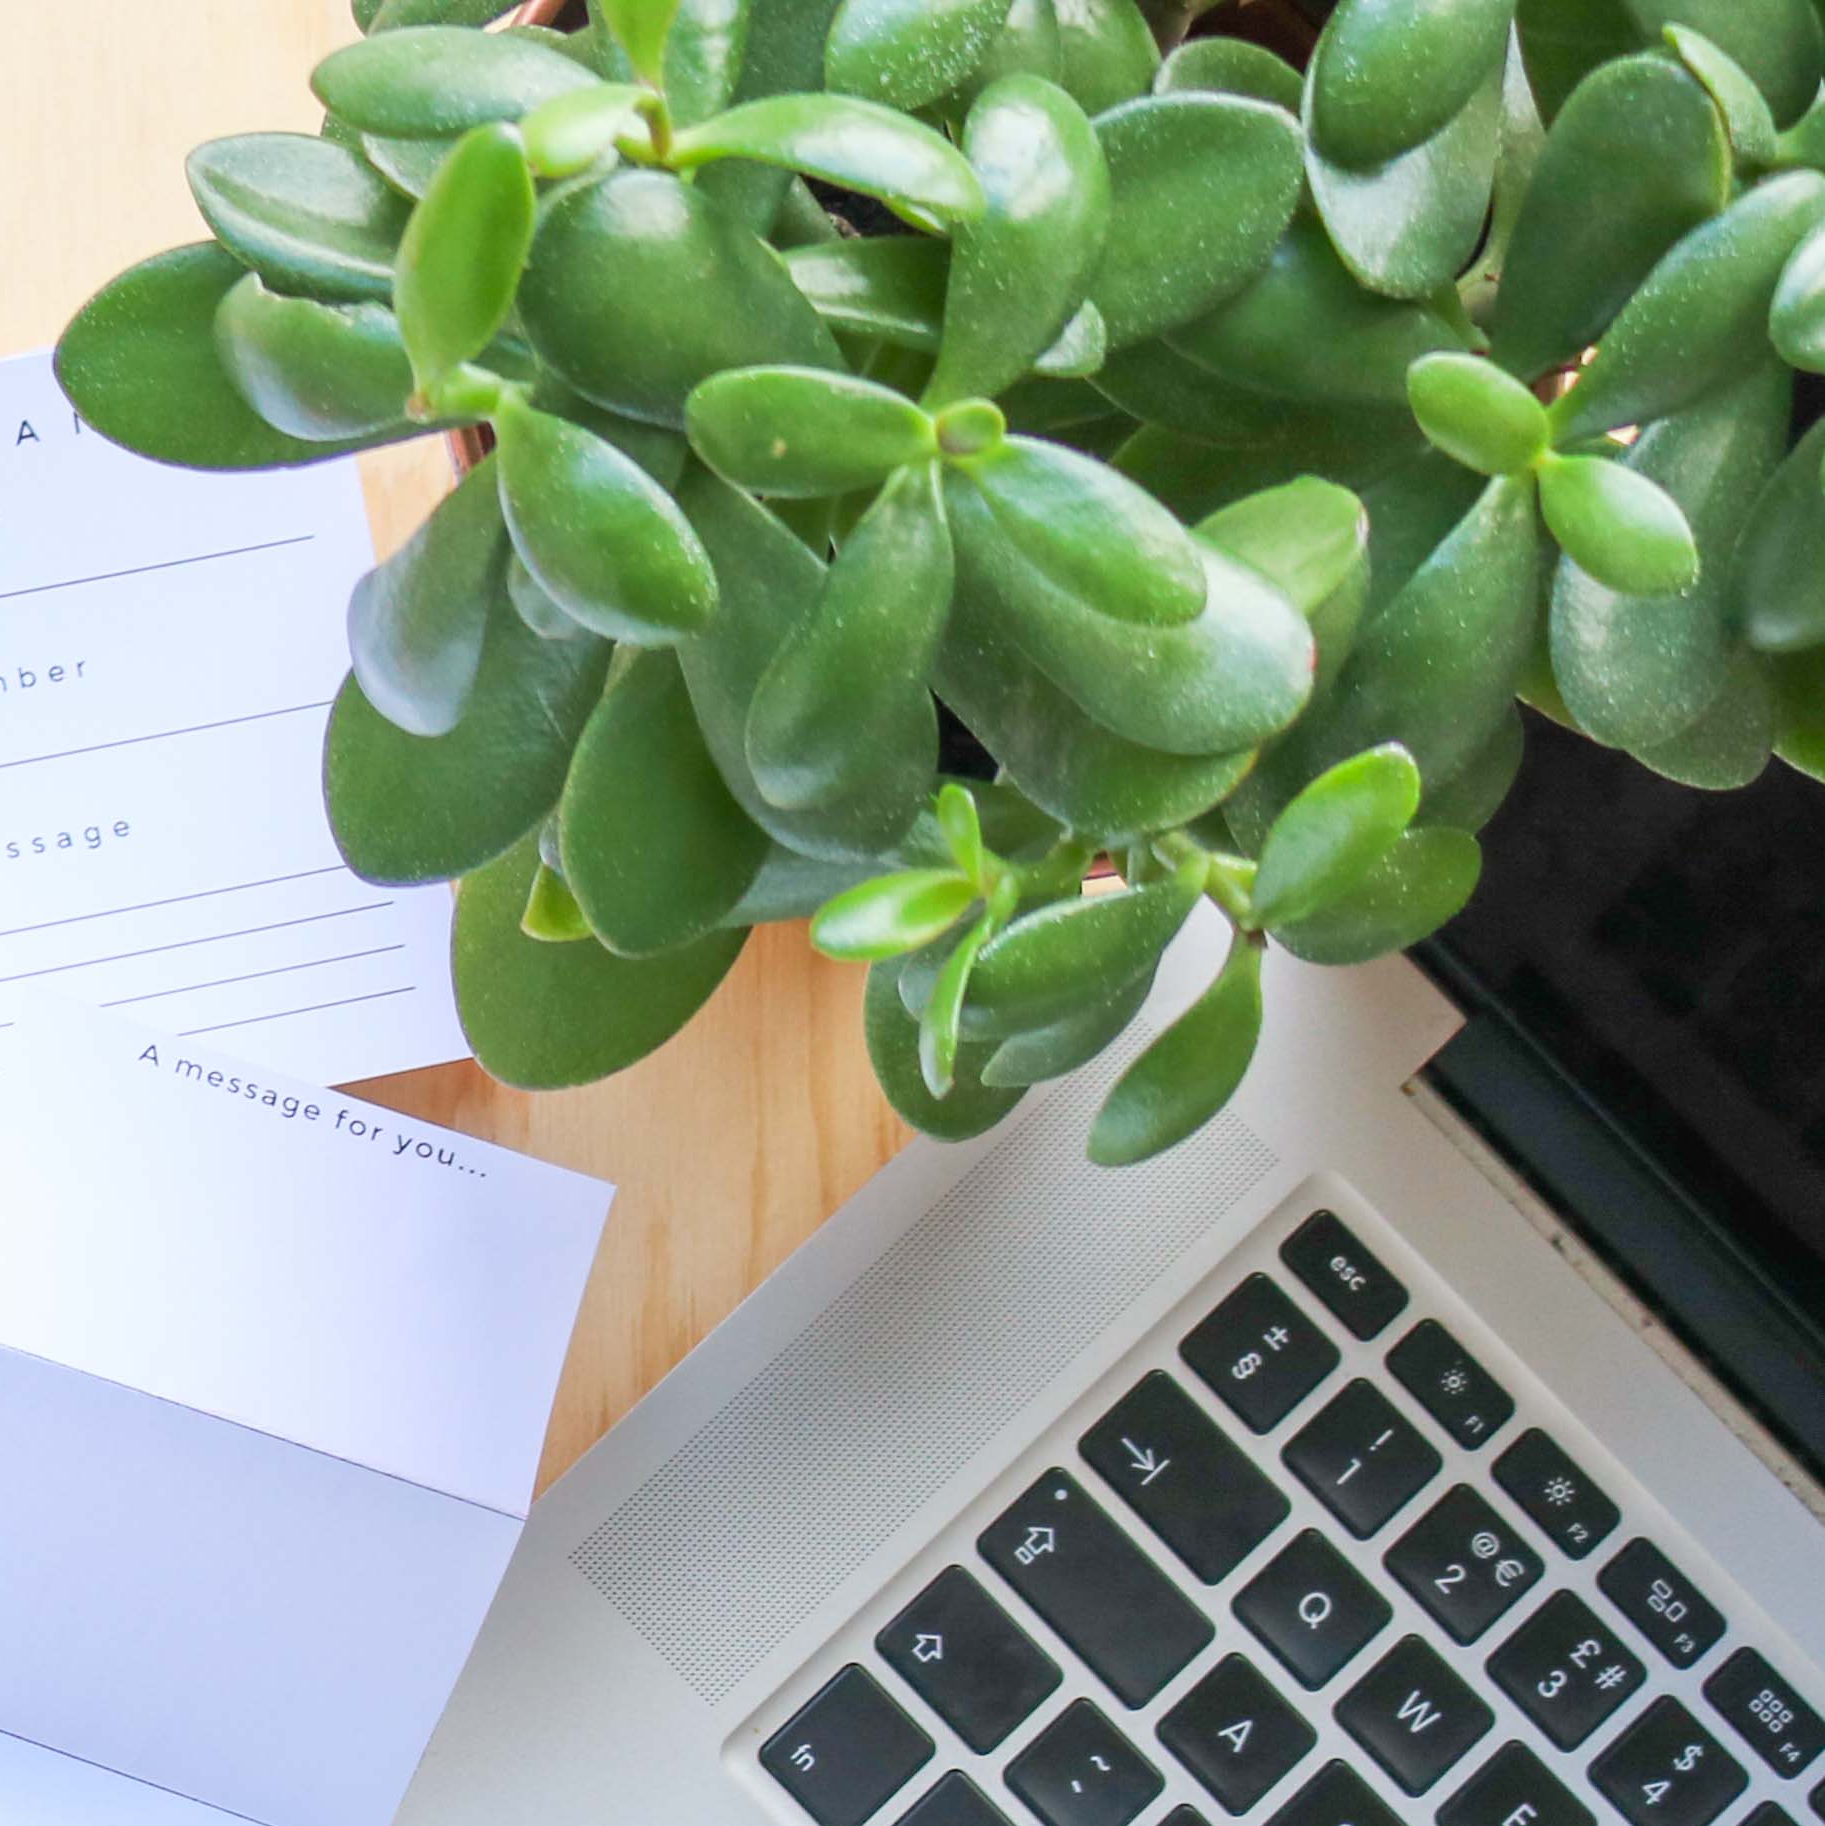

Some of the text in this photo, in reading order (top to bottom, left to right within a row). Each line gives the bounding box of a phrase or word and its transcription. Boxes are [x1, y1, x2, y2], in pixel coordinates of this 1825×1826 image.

[16, 419, 40, 446] A
[138, 1044, 159, 1067] A
[175, 1059, 321, 1121] message
[335, 1109, 383, 1141] for
[1330, 1255, 1366, 1291] esc
[1336, 1458, 1362, 1486] 1
[1471, 1531, 1500, 1559] @
[1567, 1522, 1589, 1543] F2
[1434, 1564, 1466, 1595] 2
[1495, 1559, 1525, 1587] €
[1298, 1591, 1332, 1630] Q
[1569, 1639, 1601, 1669] £
[1673, 1633, 1696, 1654] F3
[1537, 1670, 1568, 1699] 3
[1594, 1664, 1627, 1690] #
[1396, 1690, 1442, 1733] W
[1217, 1719, 1253, 1753] A
[790, 1743, 815, 1772] fn
[1673, 1745, 1704, 1771] $
[1642, 1780, 1671, 1805] 4
